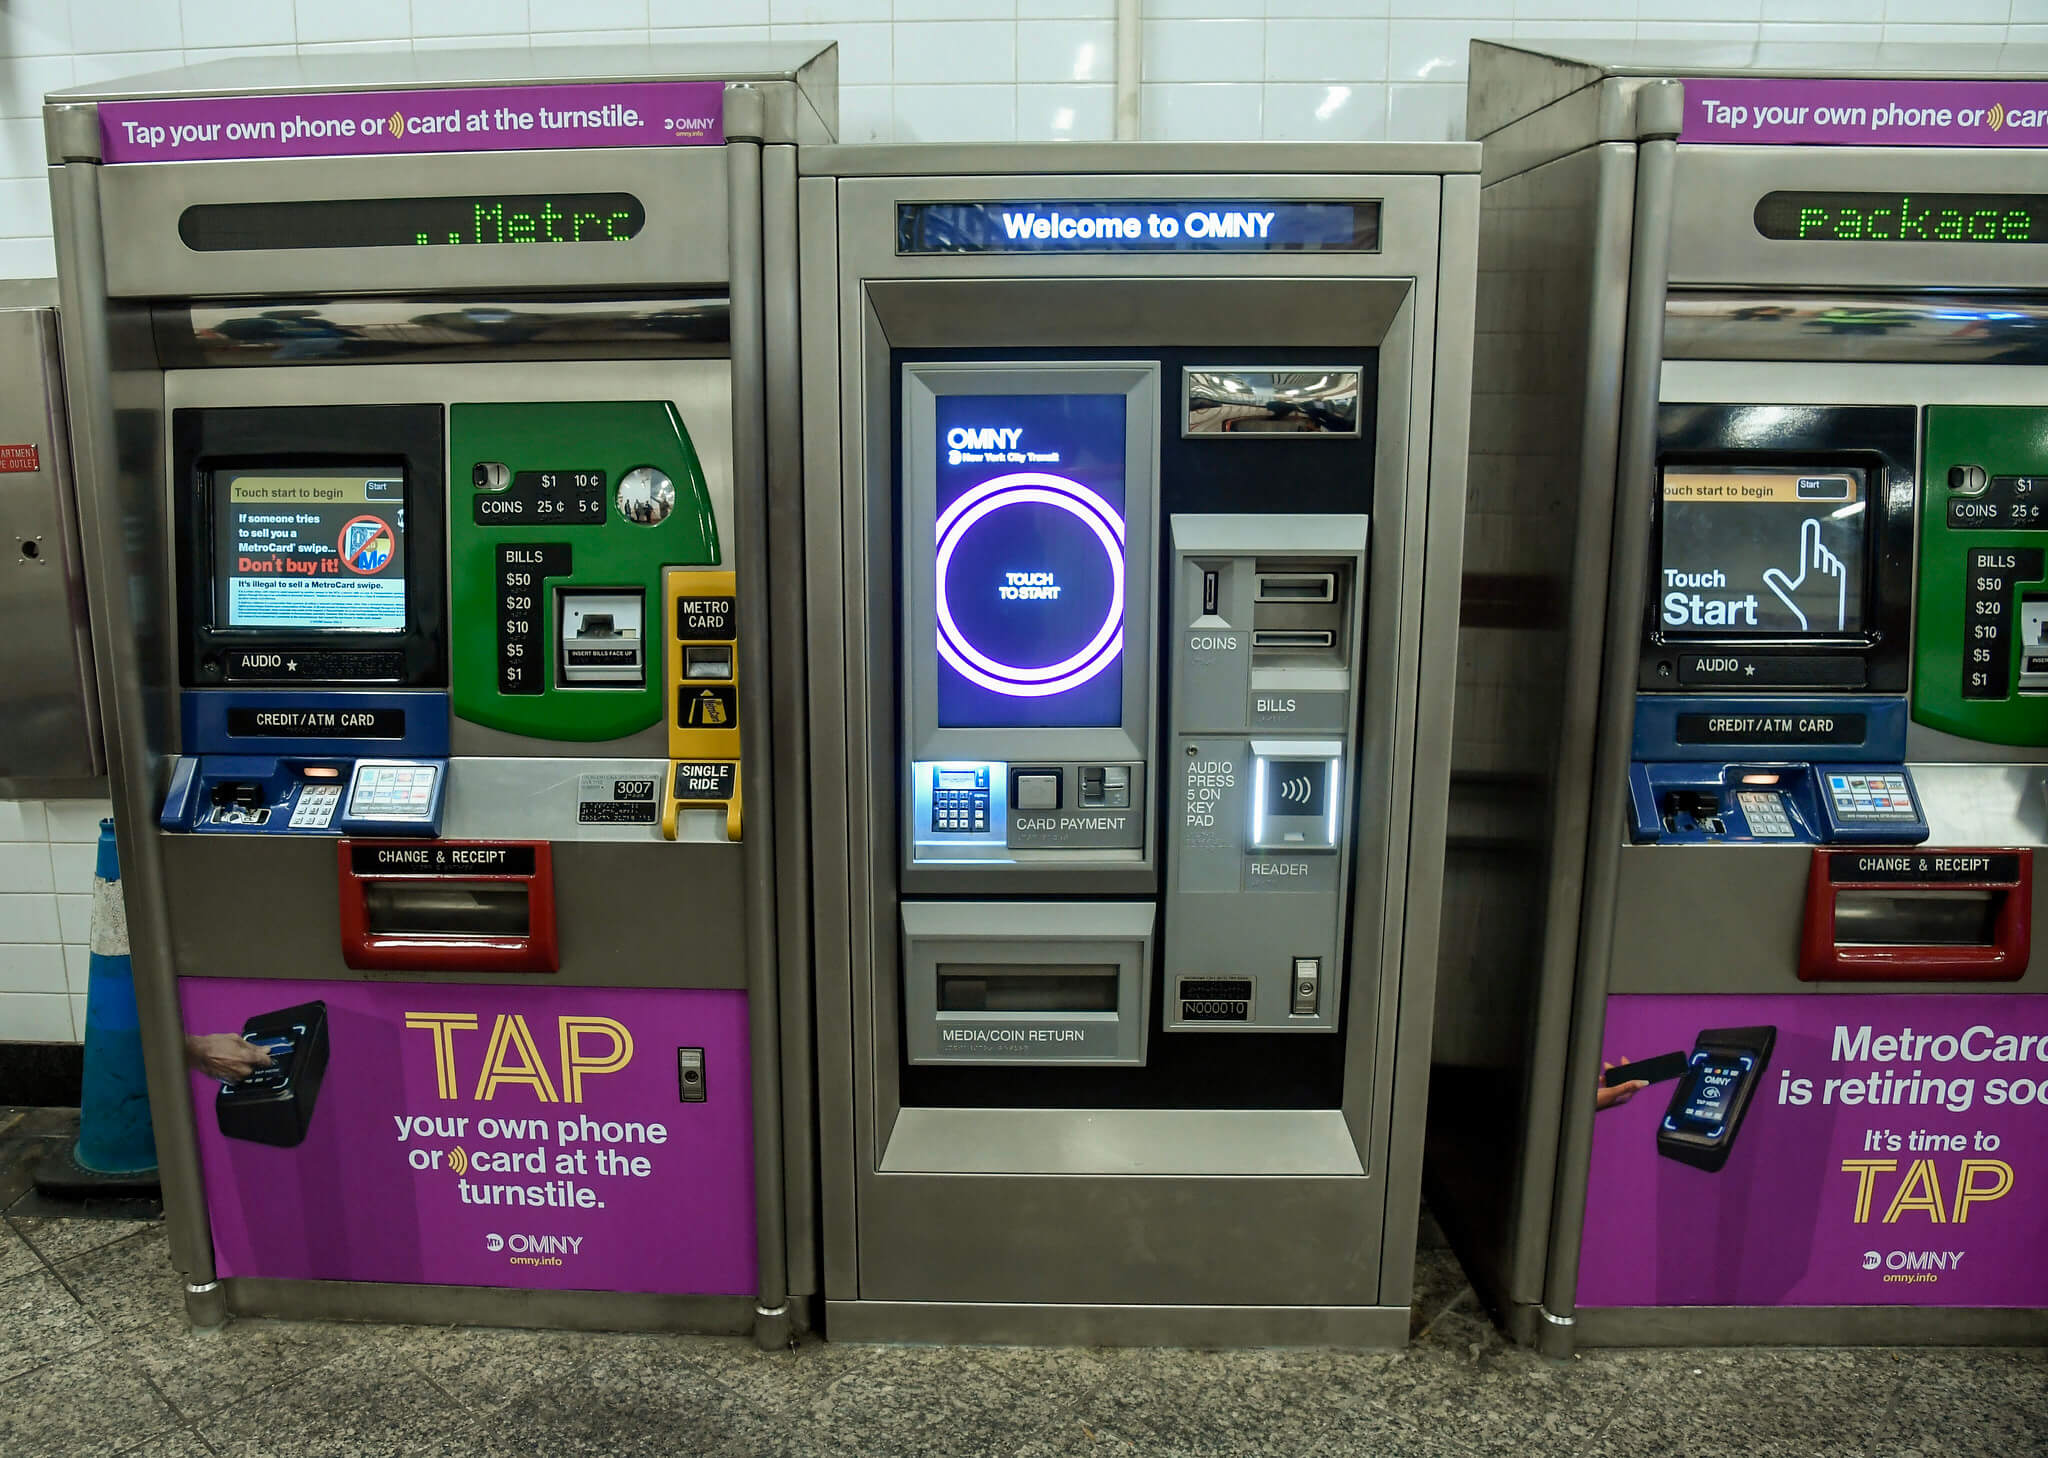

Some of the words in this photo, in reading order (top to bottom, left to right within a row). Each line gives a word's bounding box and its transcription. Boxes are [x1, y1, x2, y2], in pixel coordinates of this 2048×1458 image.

[1702, 100, 1748, 128] Tap
[1753, 106, 1808, 128] your
[1813, 108, 1866, 125] own
[1871, 103, 1952, 130] phone
[1957, 108, 1985, 126] or
[2006, 110, 2048, 127] car
[122, 121, 165, 148] Tap
[169, 123, 221, 147] your
[225, 121, 275, 140] own
[280, 115, 356, 143] phone
[360, 117, 386, 137] or
[407, 109, 461, 133] card
[466, 109, 489, 132] at
[494, 108, 534, 130] the
[539, 104, 644, 128] turnstile.
[676, 118, 715, 130] OMNY
[1003, 213, 1141, 239] Welcome
[1148, 214, 1179, 239] to
[1184, 212, 1274, 239] OMNY
[947, 428, 1023, 450] OMNY
[0, 460, 7, 469] E
[9, 459, 36, 469] OUTLET
[368, 482, 387, 490] Start
[541, 475, 556, 489] $1
[1800, 480, 1819, 489] Start
[2017, 478, 2032, 492] $1
[235, 487, 268, 498] Touch
[272, 488, 296, 498] start
[299, 488, 310, 498] to
[313, 488, 343, 500] begin
[1696, 486, 1723, 496] start
[1726, 487, 1738, 496] to
[1741, 486, 1774, 499] begin
[481, 501, 523, 514] COINS
[1955, 504, 1997, 518] COINS
[239, 514, 247, 523] If
[296, 514, 320, 523] tries
[239, 529, 249, 538] to
[251, 529, 269, 538] sell
[270, 531, 288, 540] you
[298, 544, 337, 554] swipe...
[506, 551, 543, 563] BILLS
[1977, 555, 2016, 568] BILLS
[287, 558, 319, 575] buy
[321, 558, 339, 573] it!
[506, 573, 531, 586] $50
[1006, 573, 1053, 585] TOUCH
[1664, 569, 1726, 587] Touch
[1977, 577, 2002, 591] $50
[239, 581, 251, 589] It's
[253, 581, 277, 590] illegal
[289, 581, 303, 589] sell
[312, 581, 355, 589] MetroCard
[357, 582, 383, 591] swipe.
[1017, 587, 1061, 600] START
[506, 596, 531, 610] $20
[684, 601, 729, 614] METRO
[1663, 592, 1758, 625] Start
[1975, 601, 2001, 615] $20
[506, 620, 528, 634] $10
[689, 616, 724, 628] CARD
[1974, 625, 1997, 639] $10
[1191, 637, 1237, 650] COINS
[507, 644, 523, 657] $5
[1973, 649, 1990, 663] $5
[241, 655, 282, 667] AUDIO
[1696, 659, 1739, 672] AUDIO
[507, 668, 521, 681] $1
[1972, 672, 1987, 686] $1
[1257, 700, 1296, 712] BILLS
[256, 713, 335, 726] CREDIT/ATM
[341, 714, 375, 726] CARD
[1708, 719, 1792, 732] CREDIT/ATM
[1799, 719, 1834, 732] CARD
[682, 766, 728, 777] SINGLE
[1187, 762, 1232, 774] AUDIO
[617, 782, 651, 793] 3007
[690, 778, 719, 790] RIDE
[1188, 776, 1234, 787] PRESS
[1187, 789, 1195, 800] 5
[1199, 789, 1221, 800] ON
[1187, 802, 1214, 813] KEY
[1016, 818, 1056, 830] CARD
[1060, 818, 1126, 830] PAYMENT
[1187, 815, 1214, 826] PAD
[378, 851, 429, 863] CHANGE
[436, 851, 445, 863] &
[453, 851, 506, 863] RECEIPT
[1251, 864, 1308, 876] READER
[1858, 858, 1911, 871] CHANGE
[1919, 858, 1928, 871] &
[1935, 858, 1990, 871] RECEIPT
[1186, 1002, 1245, 1014] N000010
[943, 1030, 1025, 1041] MEDIA/COIN
[1029, 1030, 1084, 1041] RETURN
[405, 1011, 634, 1103] TAP
[1778, 1069, 1813, 1105] is
[1822, 1069, 1975, 1112] retiring
[394, 1115, 469, 1141] your
[477, 1118, 548, 1139] own
[557, 1114, 667, 1146] phone
[1864, 1129, 1902, 1151] It’s
[1908, 1129, 1967, 1151] time
[1974, 1130, 2000, 1151] to
[409, 1149, 443, 1169] or
[470, 1147, 546, 1173] card
[555, 1151, 588, 1175] at
[595, 1149, 651, 1177] the
[458, 1179, 605, 1208] turnstile.
[1841, 1159, 2015, 1224] TAP
[508, 1234, 583, 1255] OMNY
[510, 1256, 562, 1266] omny.info
[1886, 1250, 1965, 1270] OMNY
[1883, 1273, 1938, 1284] omny.info
